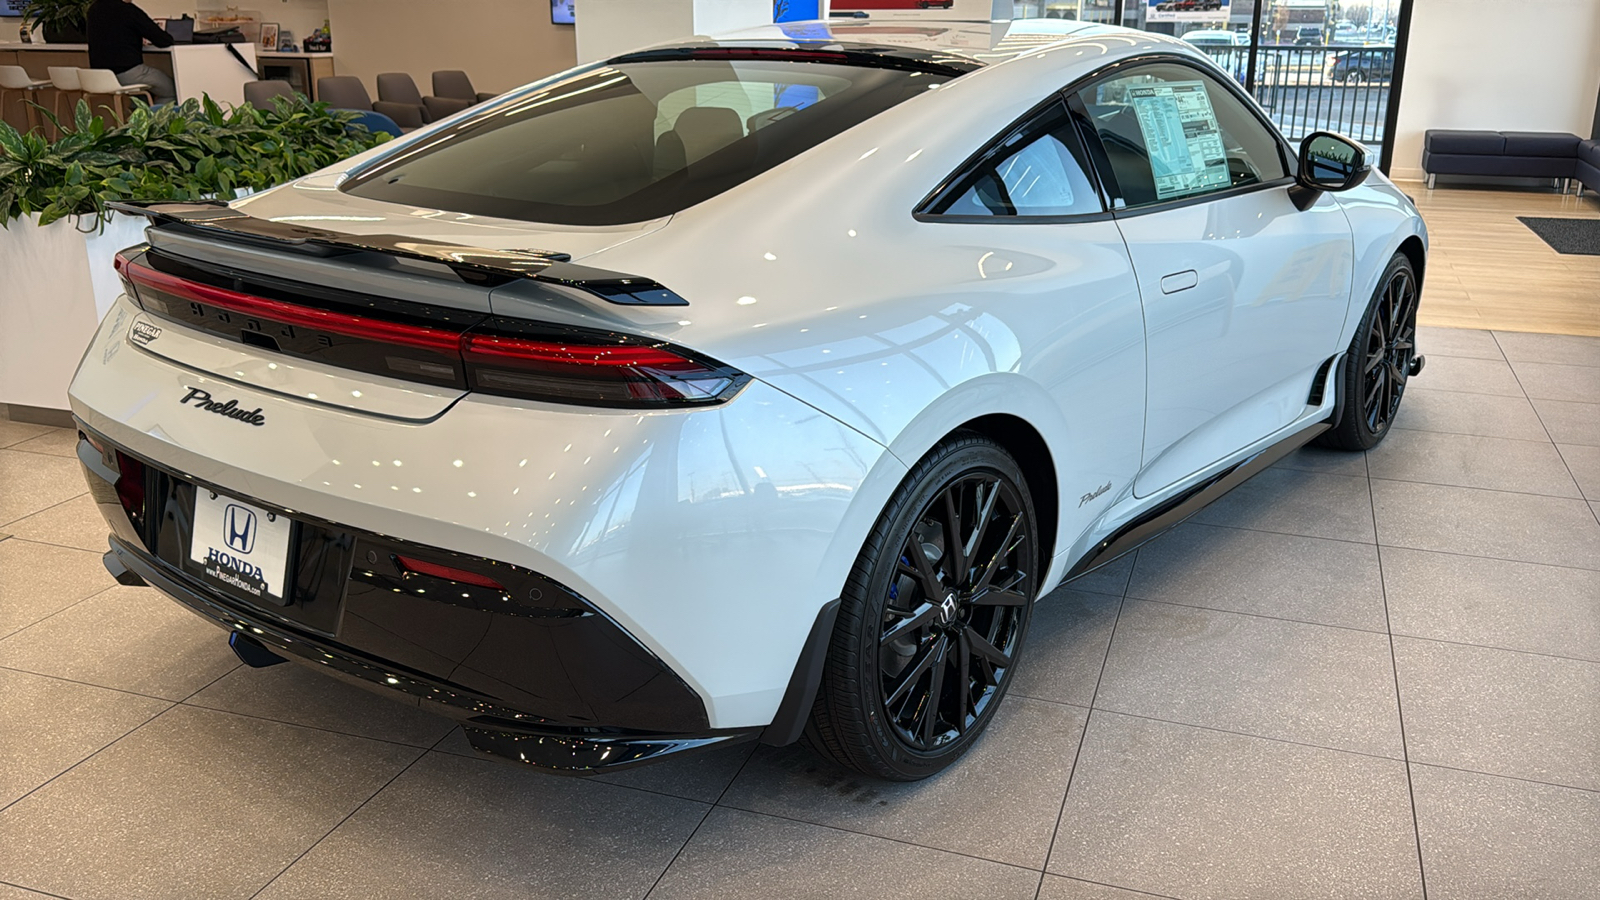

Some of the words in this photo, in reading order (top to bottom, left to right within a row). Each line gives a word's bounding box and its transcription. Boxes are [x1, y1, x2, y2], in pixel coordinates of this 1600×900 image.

[180, 386, 265, 426] Prelude
[1078, 480, 1112, 509] Prelude
[208, 546, 265, 582] HONDA
